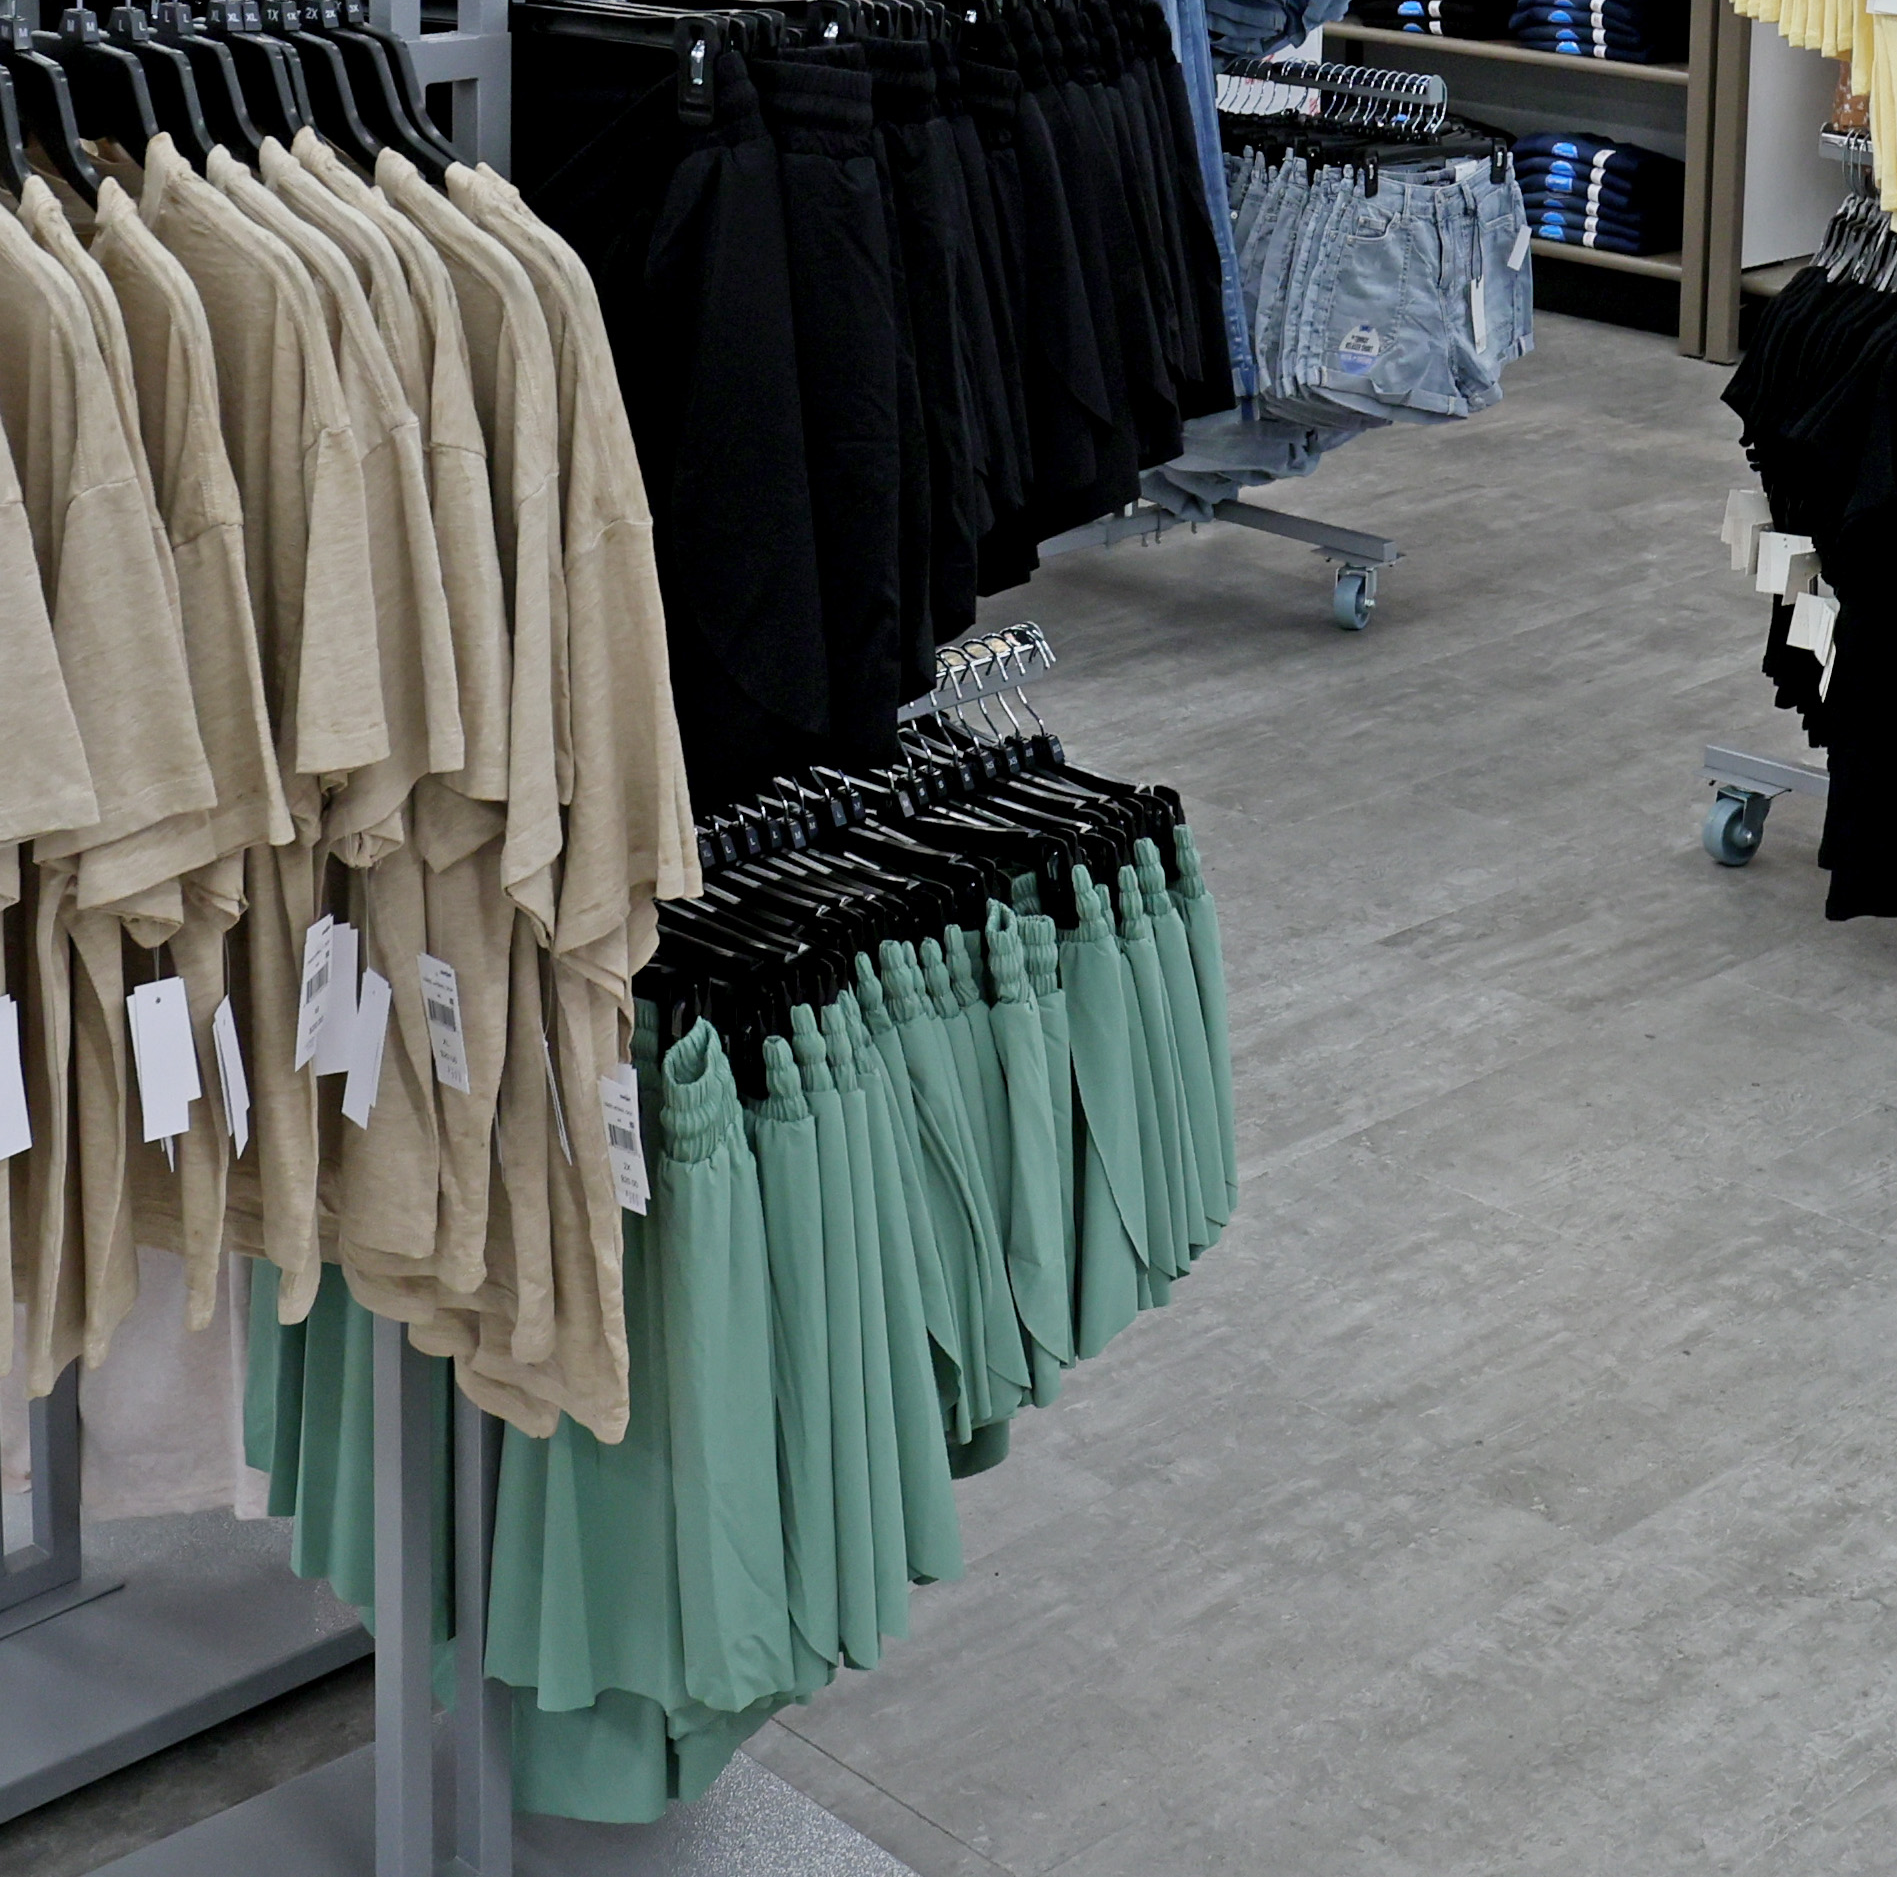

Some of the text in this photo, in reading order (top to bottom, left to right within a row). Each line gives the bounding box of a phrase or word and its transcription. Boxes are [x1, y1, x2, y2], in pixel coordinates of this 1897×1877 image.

[183, 13, 190, 22] L
[228, 13, 240, 23] XL
[246, 13, 258, 22] XL
[139, 21, 146, 31] L
[19, 28, 28, 37] M
